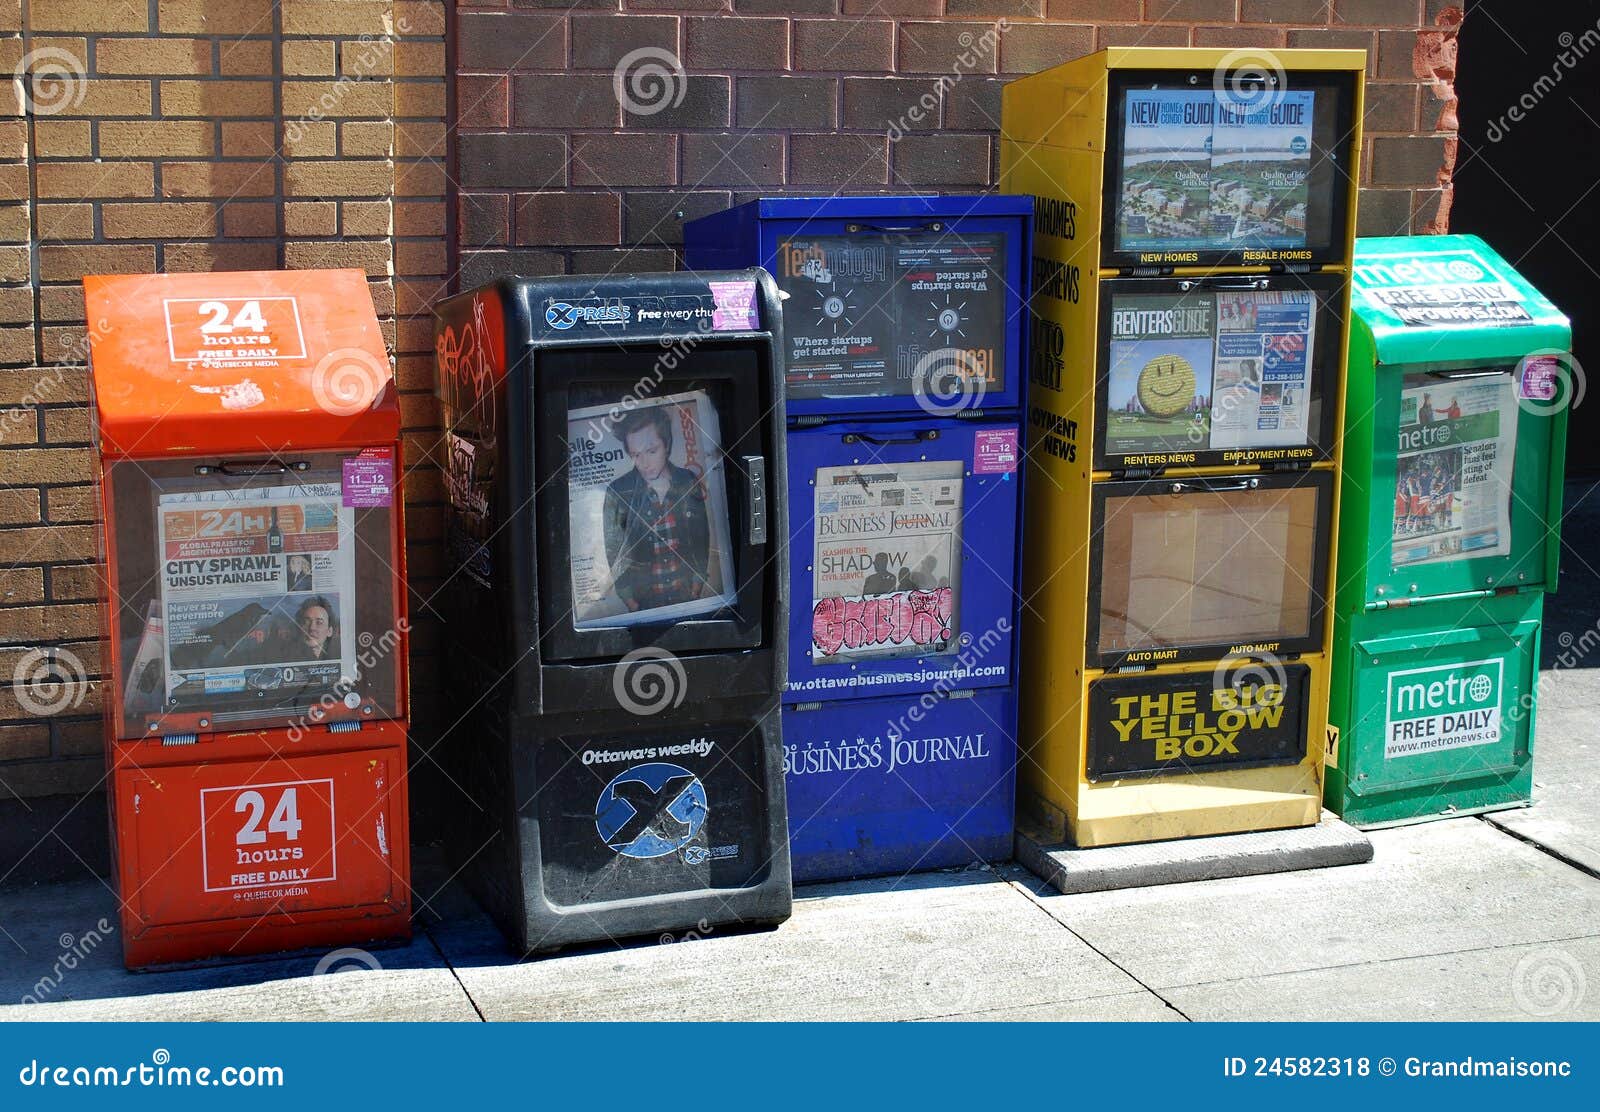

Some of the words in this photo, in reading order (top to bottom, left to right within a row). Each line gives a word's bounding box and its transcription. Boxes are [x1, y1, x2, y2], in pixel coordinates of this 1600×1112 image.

[1131, 102, 1160, 124] NEW
[1184, 102, 1214, 125] GUID
[1219, 104, 1247, 125] NEW
[1270, 104, 1305, 126] GUIDE
[1175, 170, 1198, 182] Quality
[1199, 170, 1208, 180] of
[1260, 170, 1284, 182] Quality
[1140, 253, 1162, 262] NEW
[1164, 252, 1198, 262] HOMES
[1243, 251, 1278, 260] RESALE
[1280, 250, 1312, 260] HOMES
[936, 272, 970, 282] started
[972, 270, 988, 280] get
[912, 280, 952, 291] startups
[954, 281, 988, 291] Where
[1373, 288, 1436, 305] FREE
[1439, 284, 1508, 301] DAILY
[198, 300, 268, 334] 24
[638, 309, 662, 323] free
[663, 310, 694, 322] every
[202, 334, 272, 346] hours
[793, 336, 830, 348] Where
[831, 334, 872, 347] startups
[197, 349, 234, 359] FREE
[237, 348, 278, 358] DAILY
[793, 348, 810, 360] get
[812, 346, 848, 356] started
[254, 360, 280, 368] MEDIA
[980, 444, 990, 453] 11
[1000, 444, 1010, 452] 12
[1044, 435, 1076, 463] NEWS
[1223, 450, 1286, 461] EMPLOYMENT
[1287, 448, 1313, 458] NEWS
[1464, 442, 1497, 455] Senators
[569, 448, 624, 468] attson
[1124, 455, 1166, 465] RENTERS
[1168, 454, 1196, 464] NEWS
[1464, 462, 1483, 476] sting
[1484, 461, 1493, 471] of
[350, 474, 360, 484] 11
[372, 474, 384, 484] 12
[1464, 473, 1488, 486] defeat
[200, 508, 264, 538] 24H
[820, 514, 886, 535] BUSINESS
[888, 510, 952, 535] JOURNAL
[822, 547, 853, 557] SLASHING
[166, 560, 206, 575] CITY
[209, 555, 281, 572] SPRAWL
[822, 552, 908, 574] SHADW
[822, 573, 838, 582] CIVIL
[840, 572, 864, 581] SERVICE
[168, 604, 200, 613] Never
[201, 602, 218, 612] say
[168, 610, 224, 620] nevermore
[1229, 645, 1254, 654] AUTO
[1254, 643, 1280, 654] MART
[1127, 652, 1152, 662] AUTO
[1152, 650, 1178, 661] MART
[1397, 672, 1493, 713] metro
[1112, 691, 1197, 720] THE
[1212, 684, 1284, 712] BIG
[1110, 706, 1285, 742] YELLOW
[1392, 718, 1436, 742] FREE
[1442, 709, 1494, 734] DAILY
[1155, 731, 1240, 761] BOX
[1326, 729, 1338, 756] Y
[1387, 730, 1498, 754] www.metronews.ca
[582, 747, 656, 765] Ottawa's
[657, 738, 716, 757] weekly
[783, 742, 882, 775] BUSINESS
[886, 734, 990, 774] JOURNAL
[234, 788, 302, 845] 24
[236, 847, 304, 865] hours
[231, 872, 265, 886] FREE
[270, 868, 309, 882] DAILY
[284, 887, 309, 898] MEDIA
